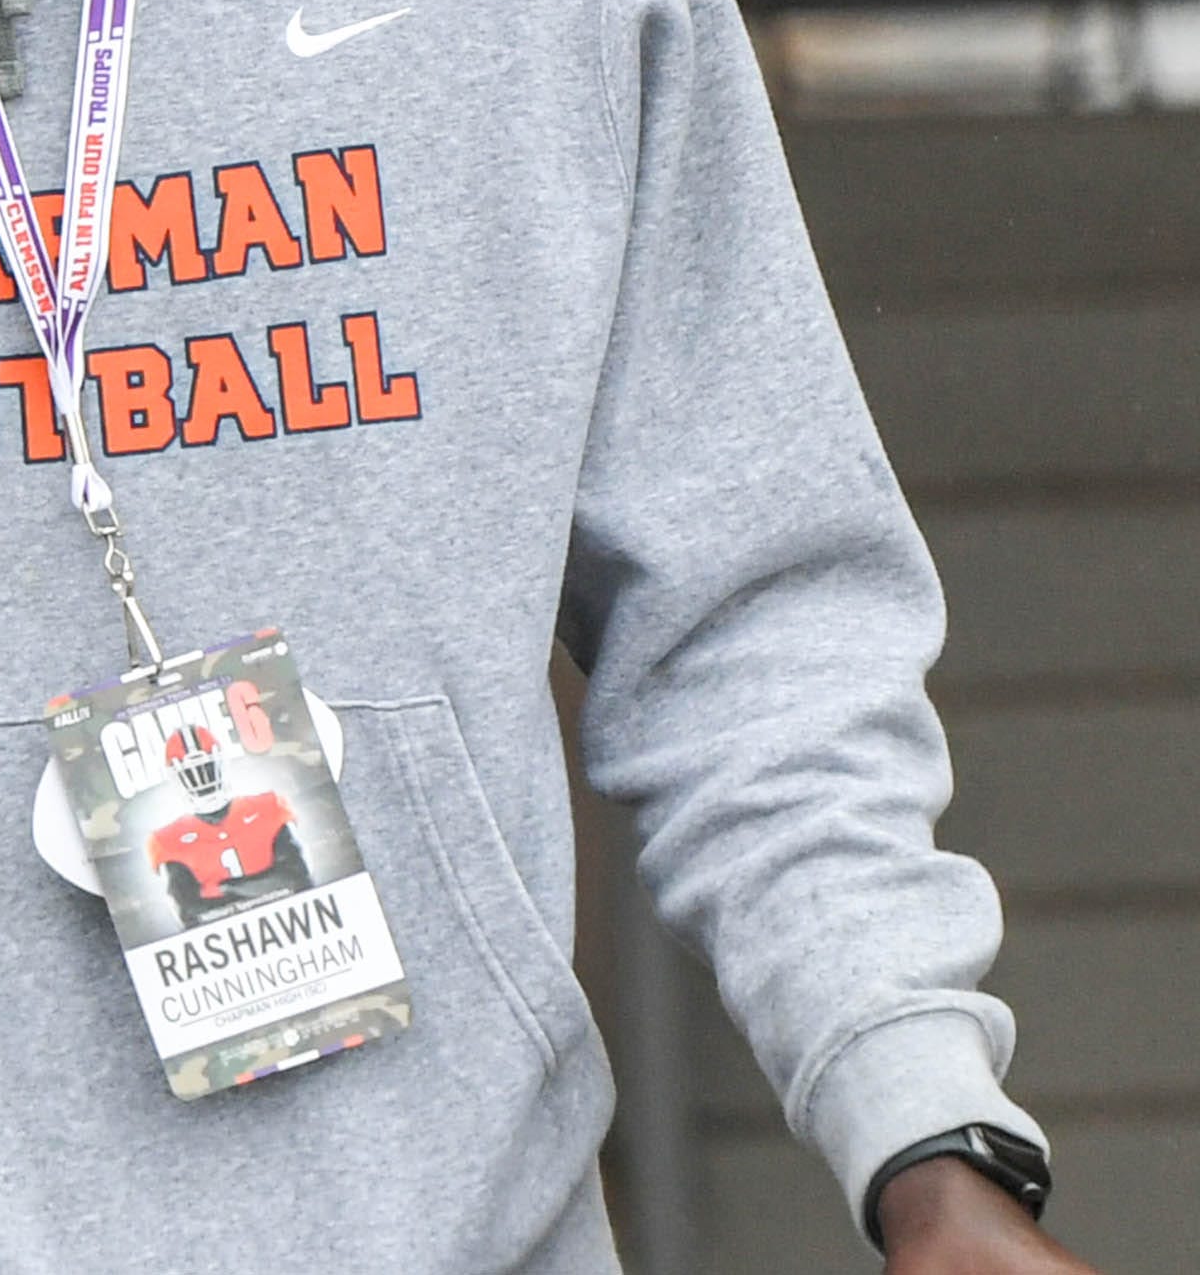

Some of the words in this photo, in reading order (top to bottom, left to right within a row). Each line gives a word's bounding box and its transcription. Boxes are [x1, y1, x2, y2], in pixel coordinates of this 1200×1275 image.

[88, 48, 113, 127] TROOPS
[83, 133, 104, 175] OUR
[78, 181, 98, 219] FOR
[76, 224, 93, 247] IN
[6, 202, 55, 313] CLEMSON
[70, 252, 90, 291] ALL
[155, 893, 344, 988] RASHAWN
[161, 934, 365, 1023] CUNNINGHAM
[215, 1001, 272, 1027] CHAPMAN
